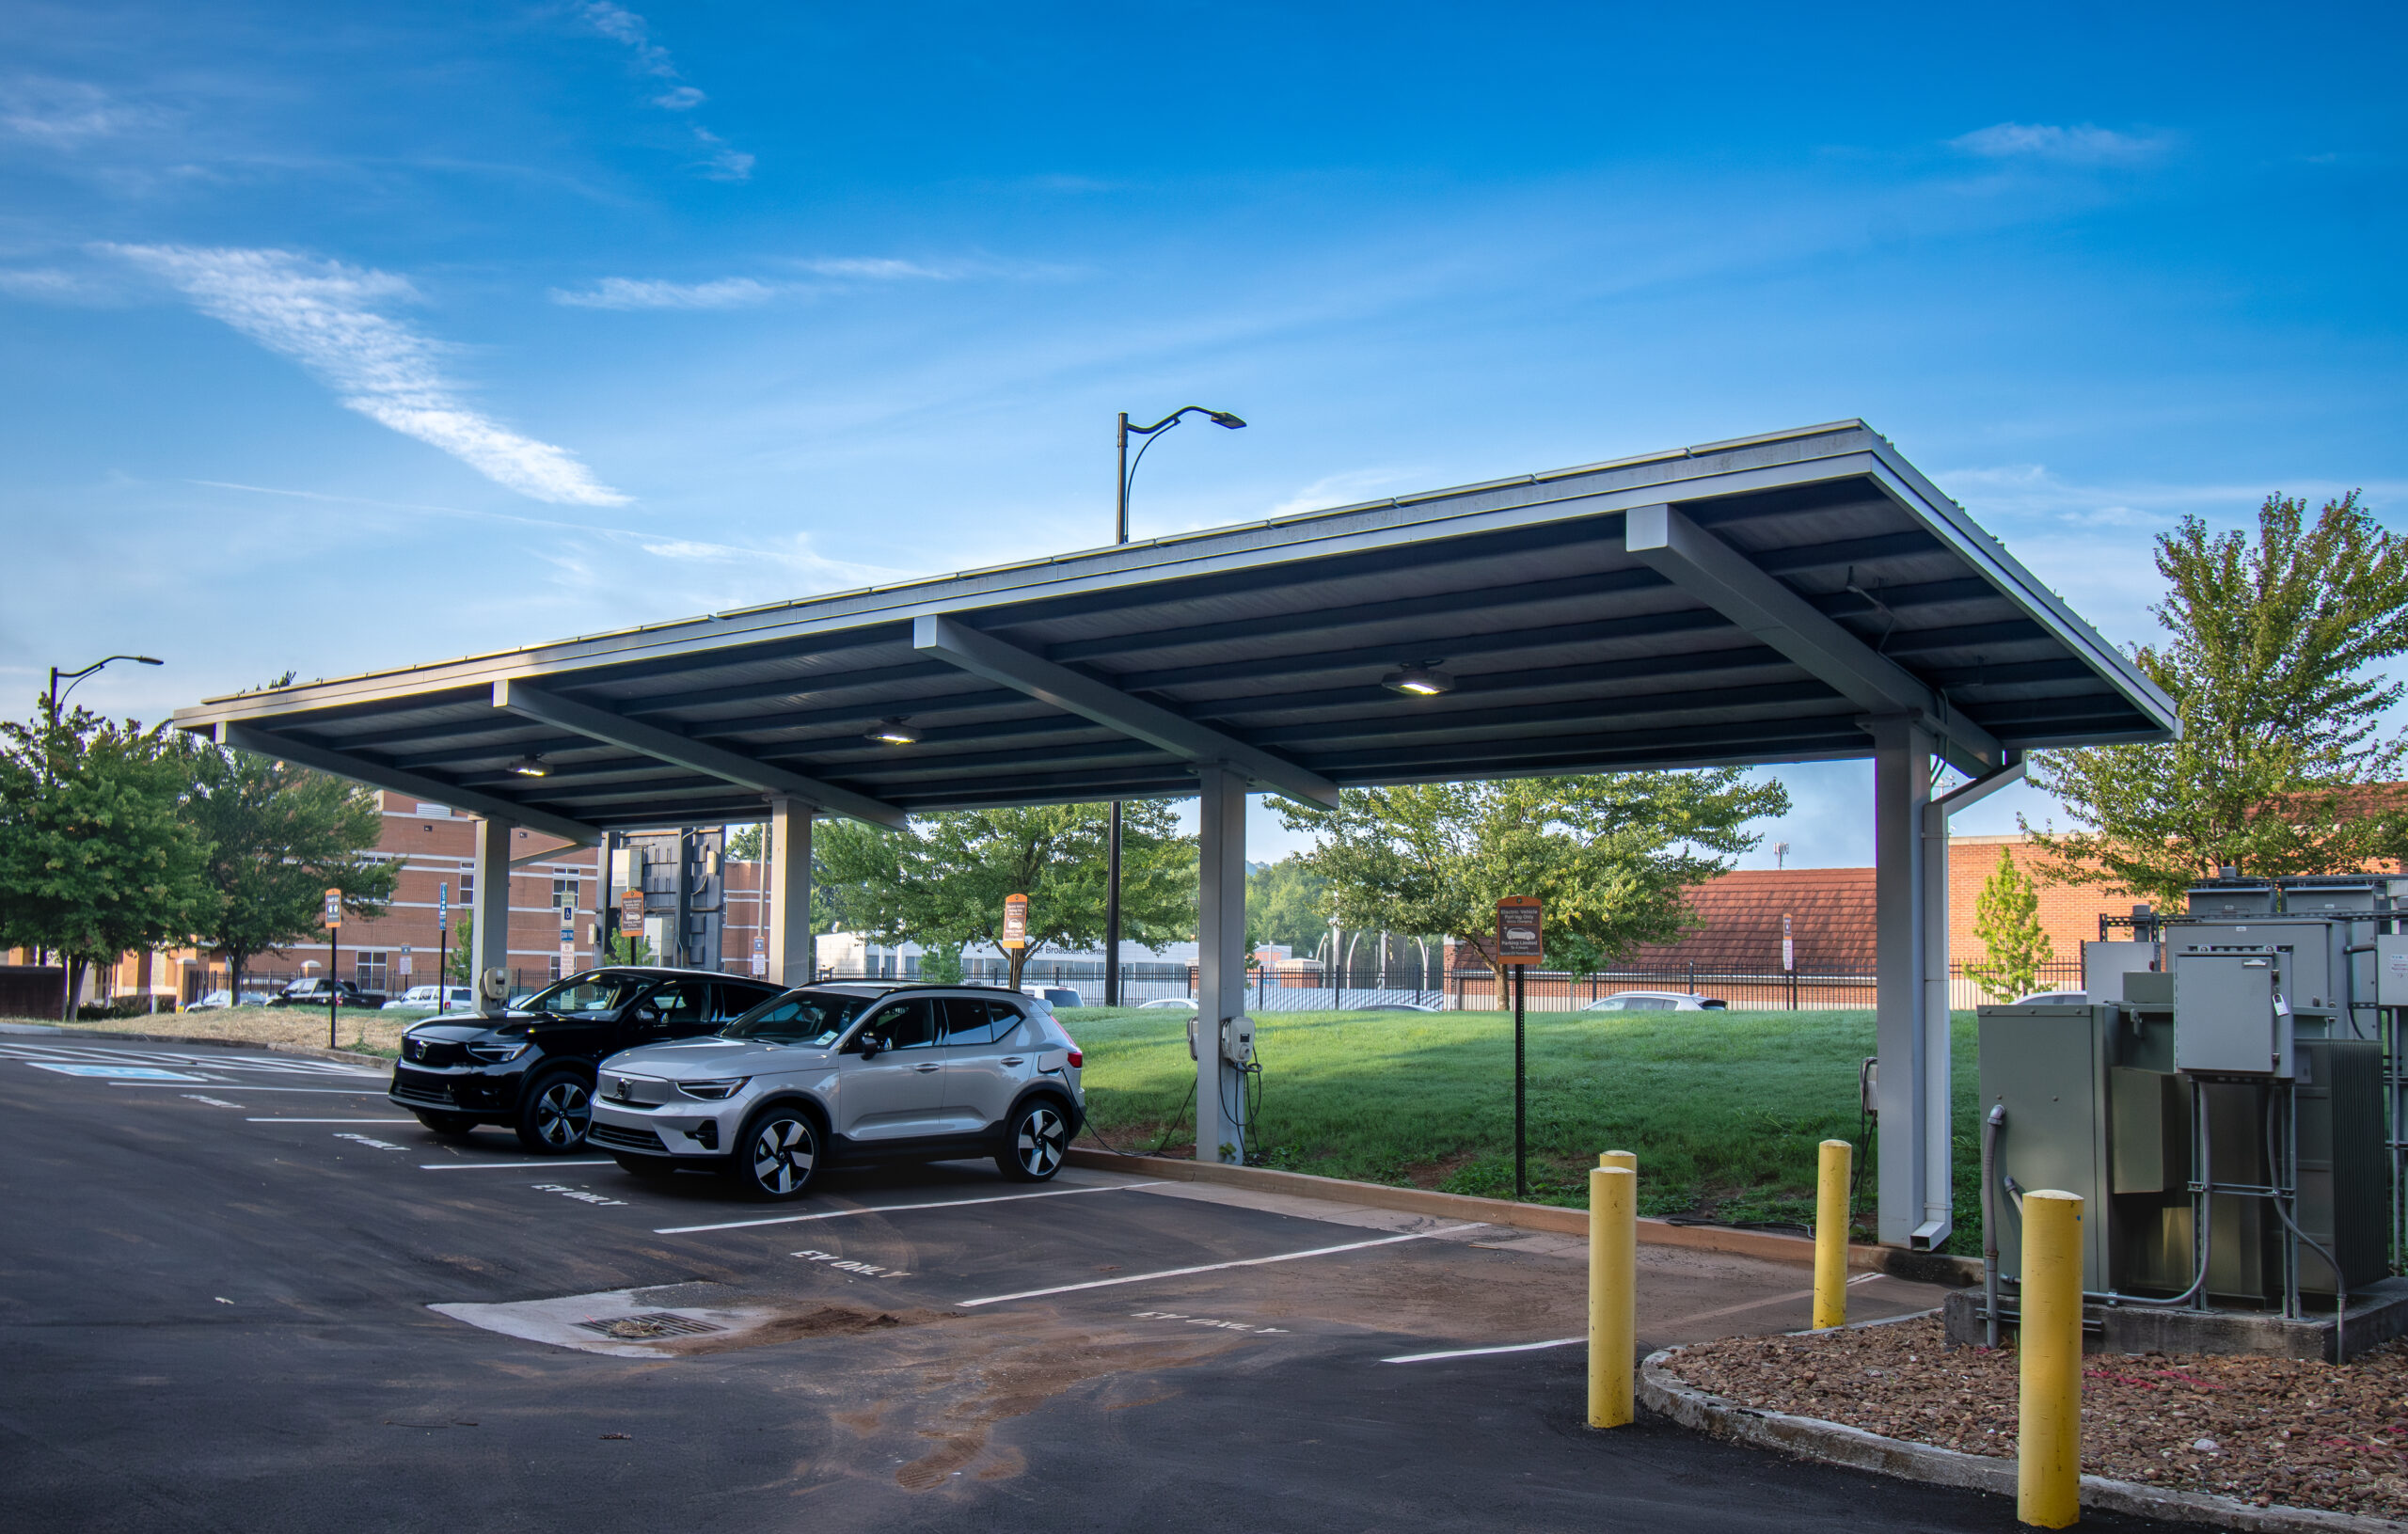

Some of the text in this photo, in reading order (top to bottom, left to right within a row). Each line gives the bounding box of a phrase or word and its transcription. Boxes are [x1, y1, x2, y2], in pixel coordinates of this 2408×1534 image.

[1045, 945, 1083, 955] Broadcast
[562, 1192, 629, 1206] ONLY
[790, 1250, 911, 1278] EV ONLY
[1129, 1311, 1291, 1334] EV ONLY
